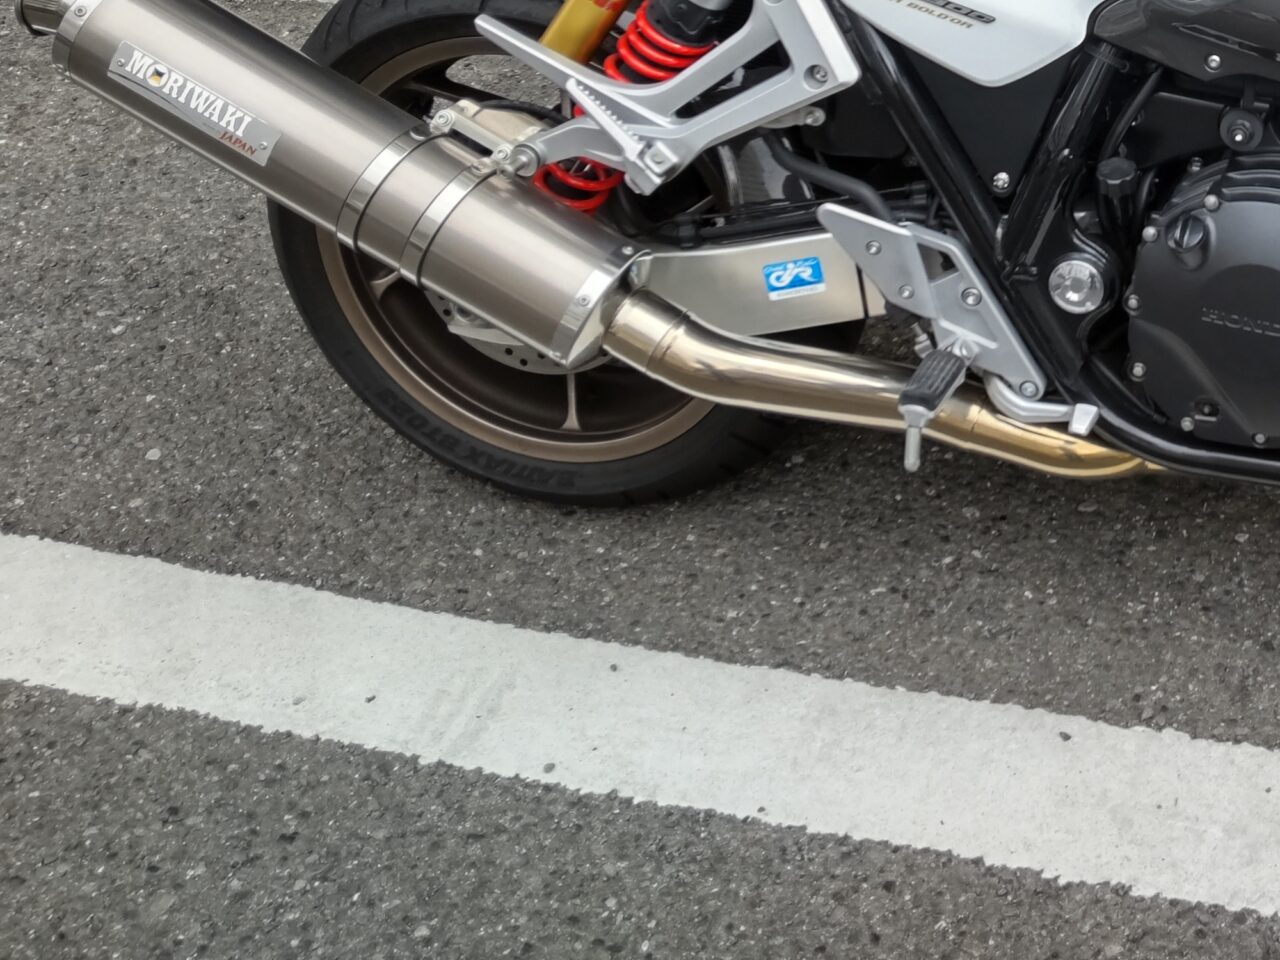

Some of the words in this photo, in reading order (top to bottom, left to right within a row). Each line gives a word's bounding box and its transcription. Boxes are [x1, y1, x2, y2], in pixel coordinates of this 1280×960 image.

[906, 1, 974, 29] BOLD'OR
[124, 50, 253, 137] MORIWAKI
[218, 131, 258, 156] JAPAN
